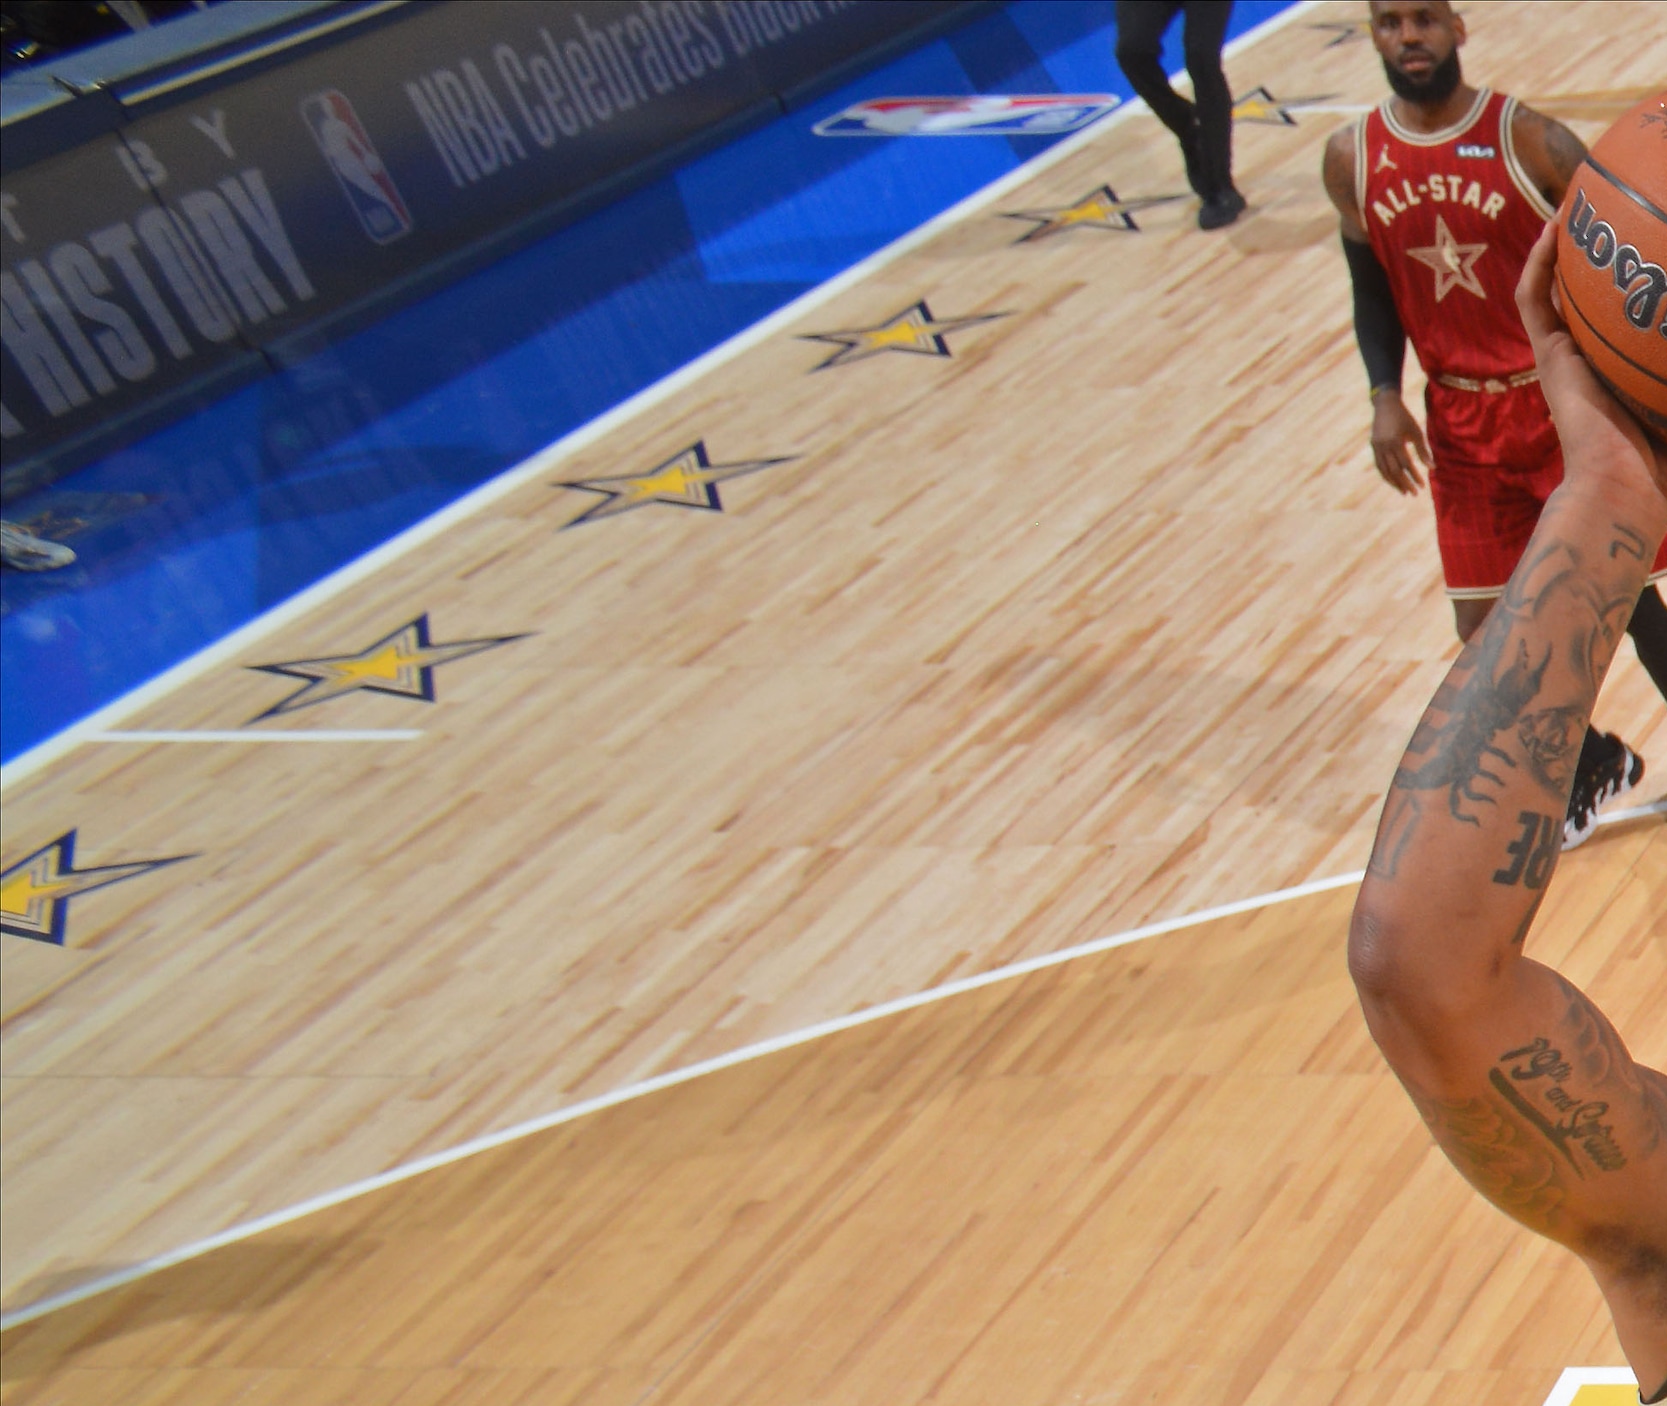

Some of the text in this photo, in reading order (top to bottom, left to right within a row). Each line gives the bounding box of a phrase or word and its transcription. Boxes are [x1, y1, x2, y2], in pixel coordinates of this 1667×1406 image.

[408, 57, 528, 187] NBA
[493, 0, 727, 149] Celebrates
[1372, 173, 1506, 228] ALL-STAR
